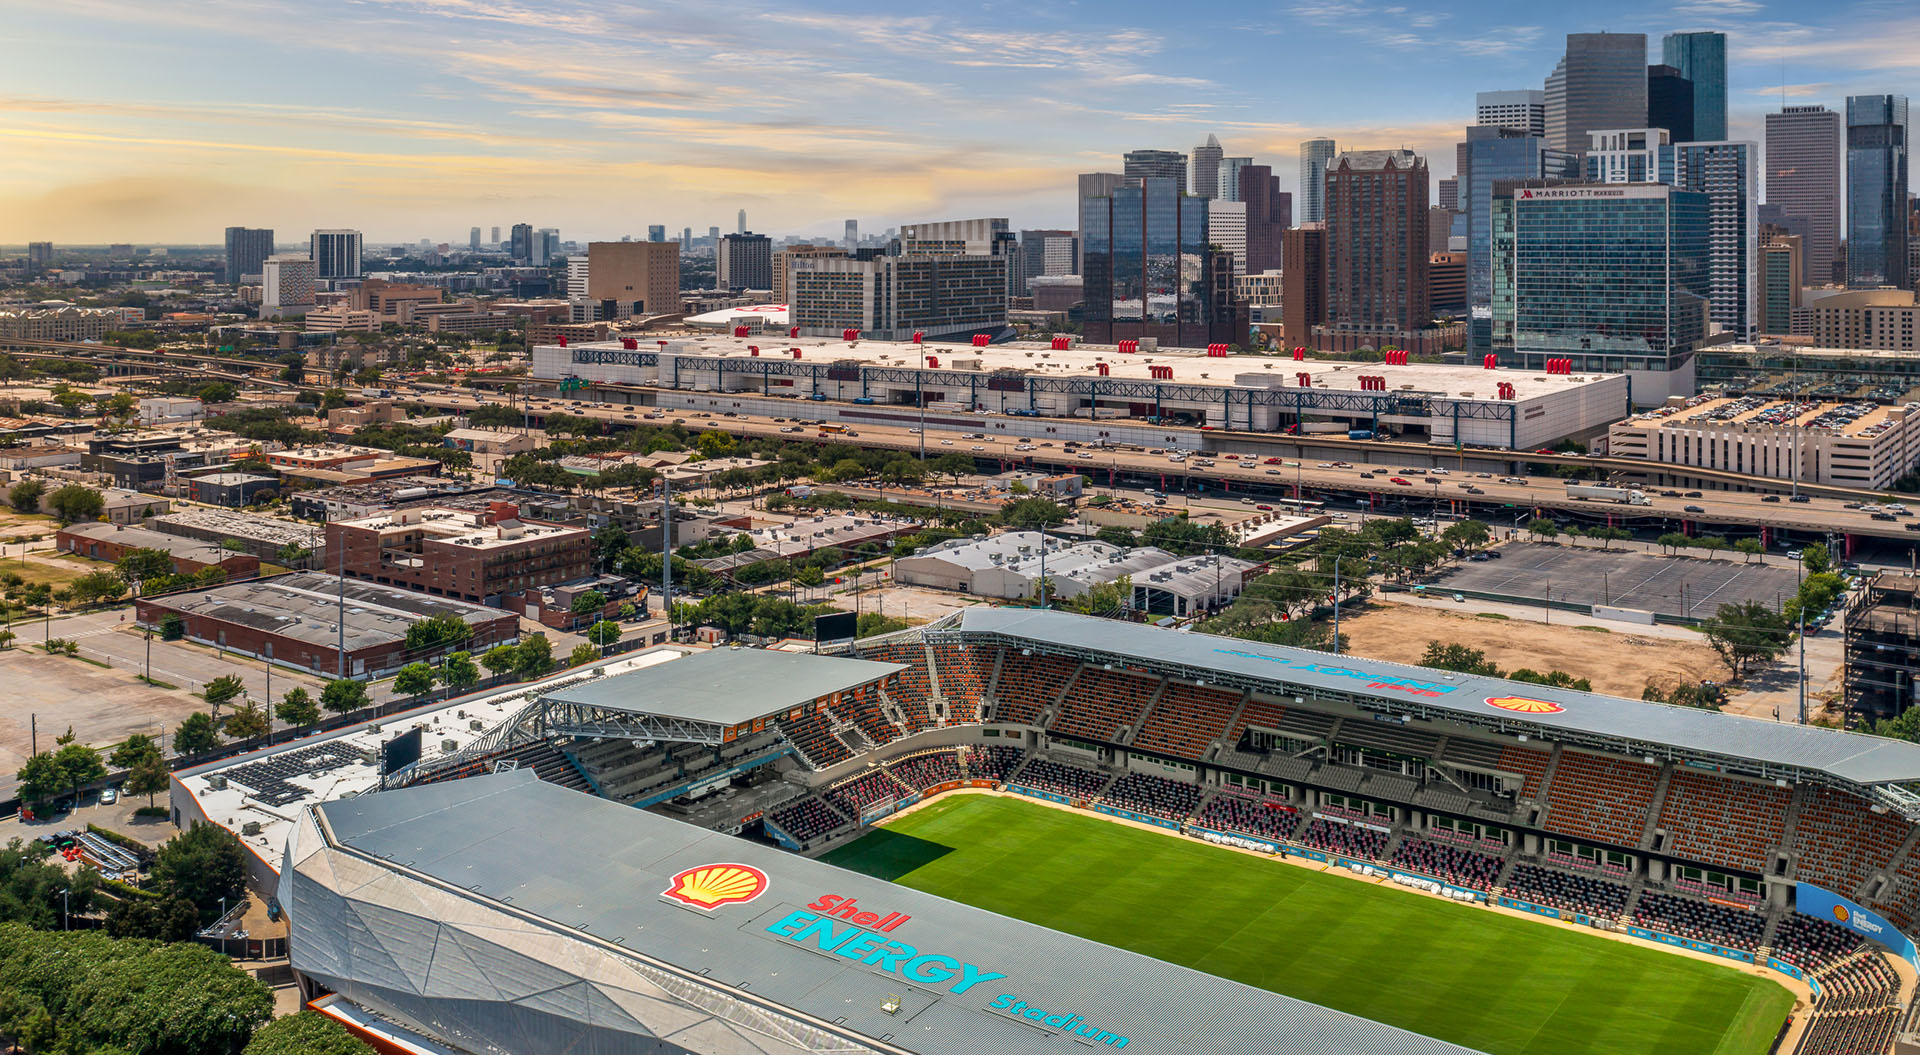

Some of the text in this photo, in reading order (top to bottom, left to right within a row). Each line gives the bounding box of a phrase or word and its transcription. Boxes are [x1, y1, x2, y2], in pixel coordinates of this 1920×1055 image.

[1535, 190, 1592, 198] MARRIOTT
[791, 261, 815, 269] Hilton
[1288, 664, 1458, 693] ENERGY
[1367, 682, 1444, 698] Shell
[807, 894, 911, 933] Shell
[765, 910, 1007, 996] ENERGY
[988, 993, 1131, 1049] Stadium
